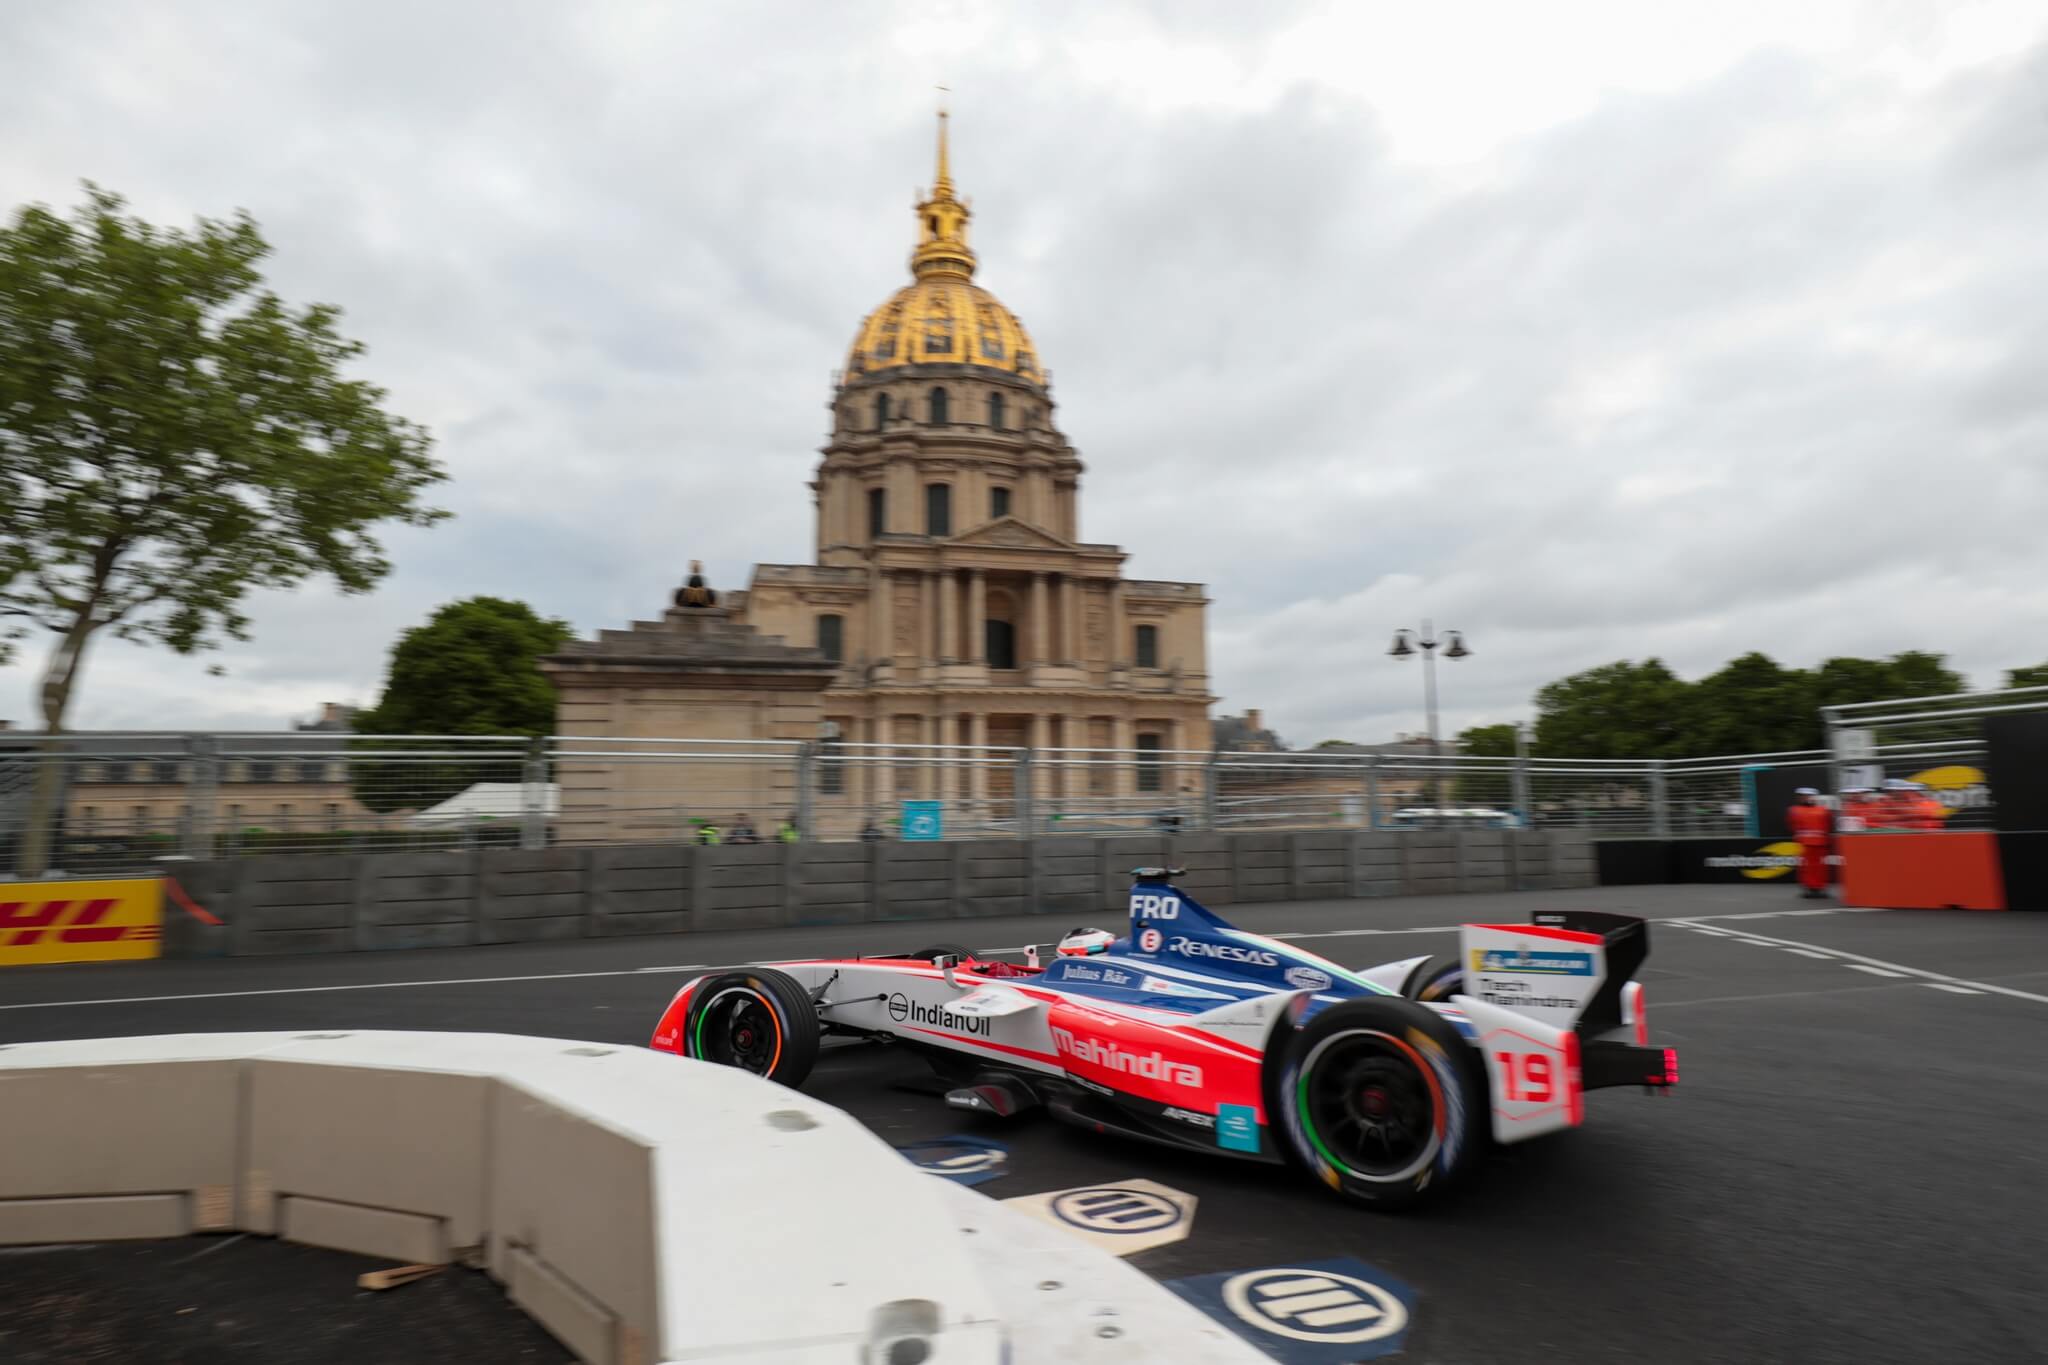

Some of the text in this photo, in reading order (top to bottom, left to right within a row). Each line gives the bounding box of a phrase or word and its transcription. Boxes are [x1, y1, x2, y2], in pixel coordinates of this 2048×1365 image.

[1129, 894, 1181, 920] FRO
[1170, 937, 1278, 966] RENESAS
[1062, 964, 1132, 985] Julius Bär
[1480, 978, 1531, 992] Tech
[911, 1000, 991, 1036] IndianOil
[1494, 1052, 1555, 1102] 19
